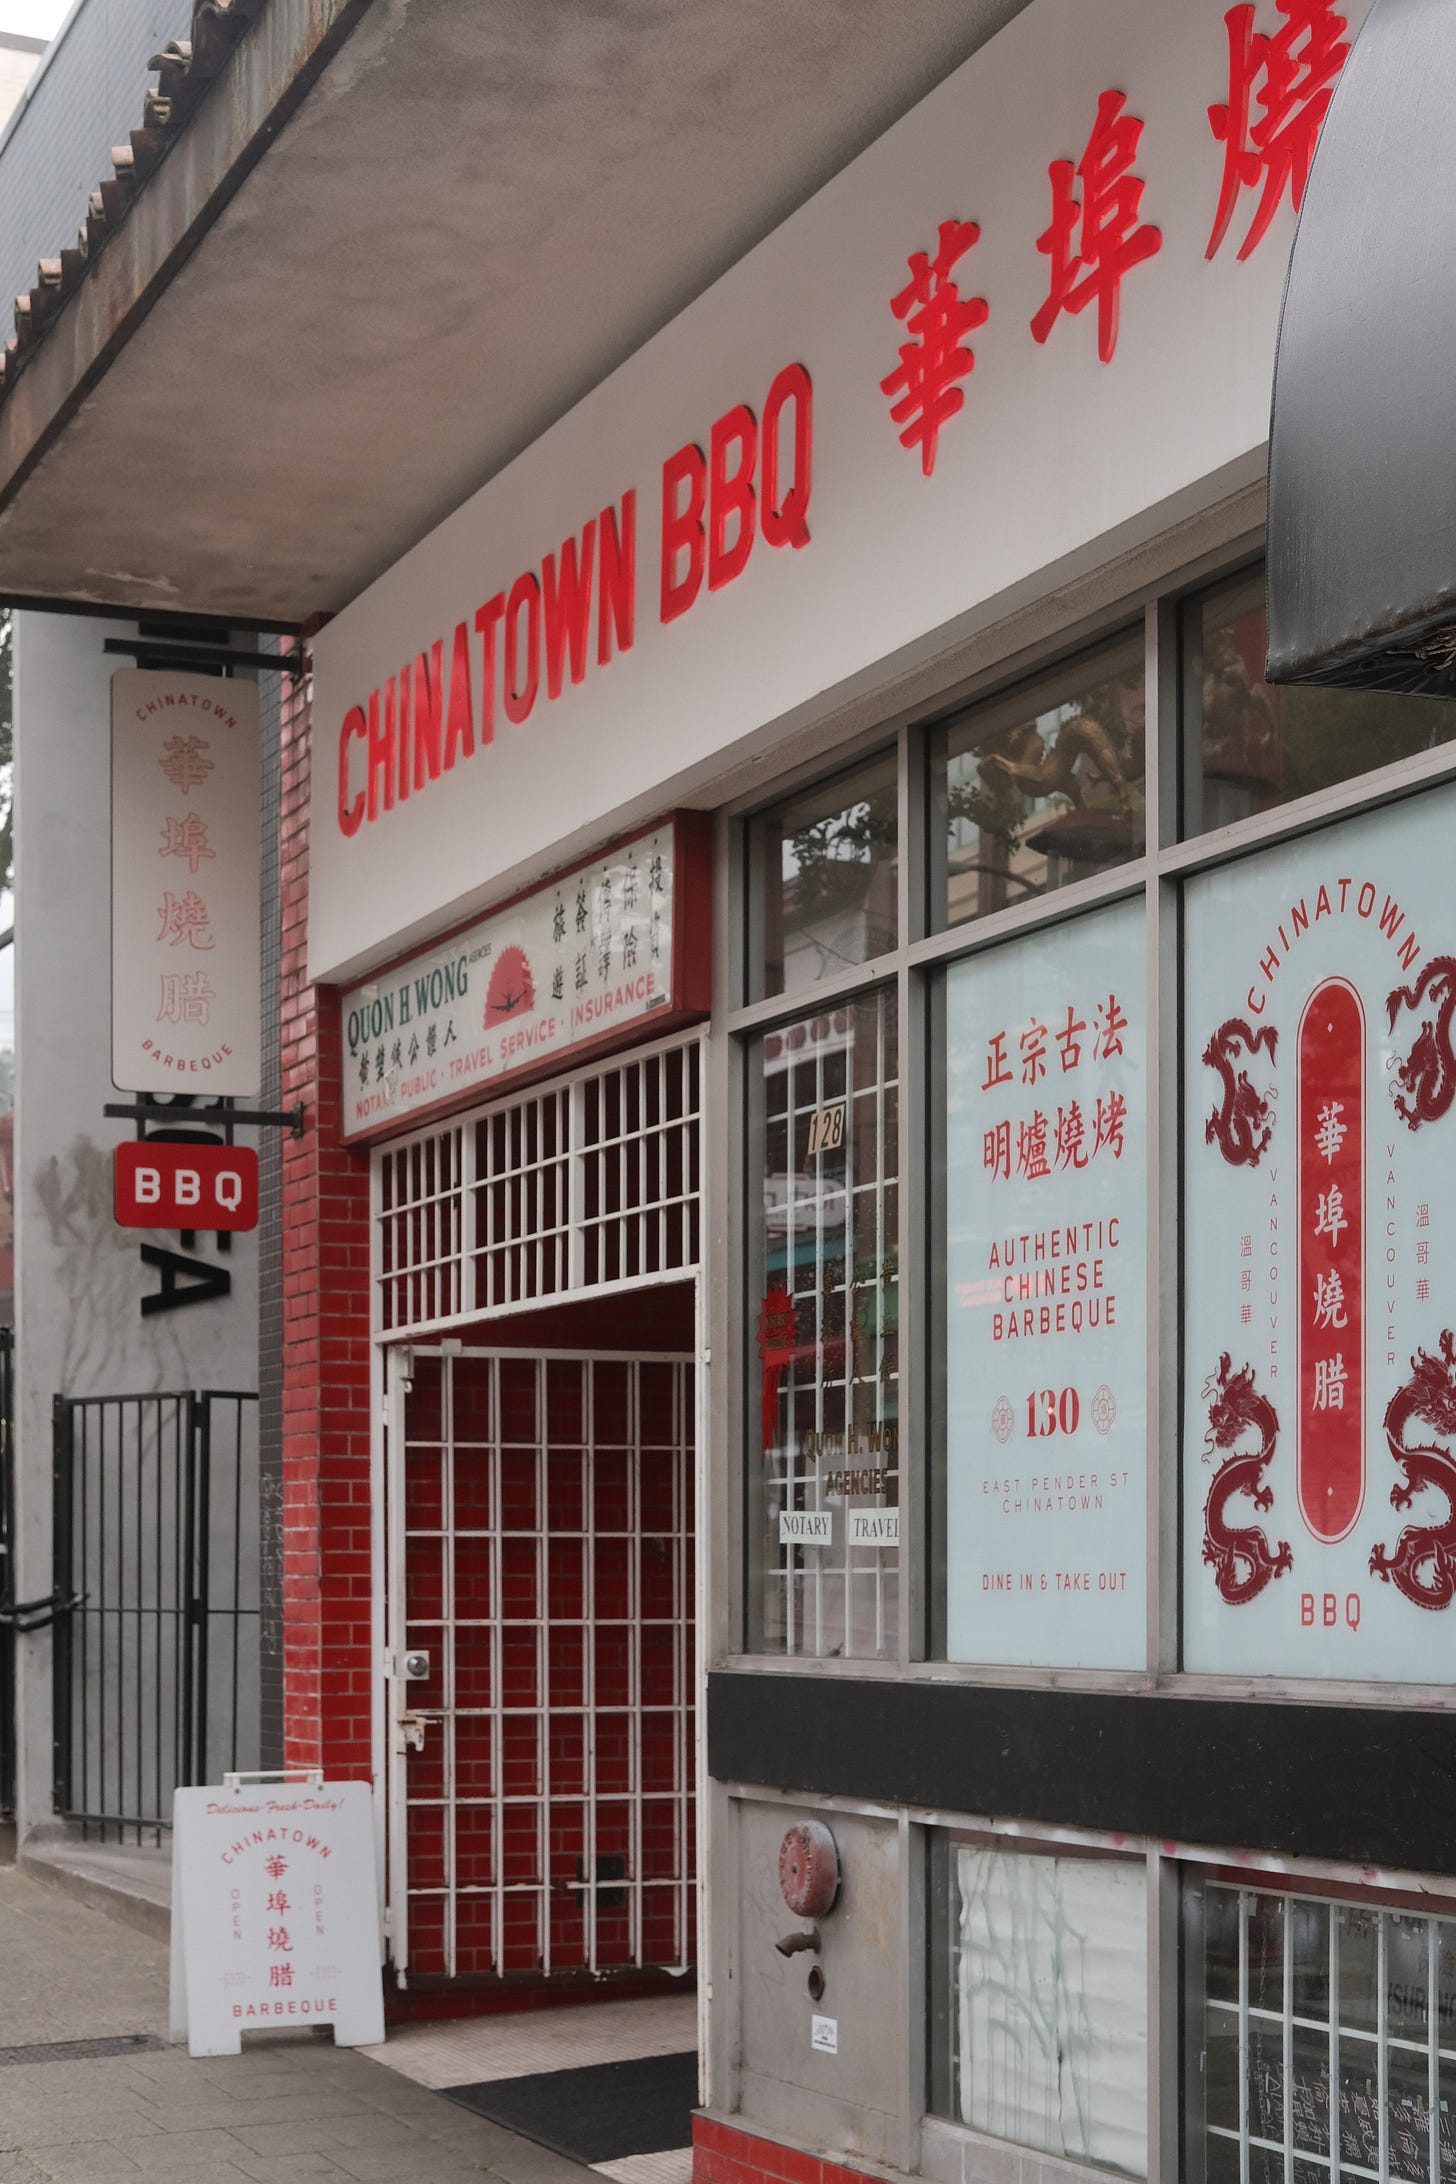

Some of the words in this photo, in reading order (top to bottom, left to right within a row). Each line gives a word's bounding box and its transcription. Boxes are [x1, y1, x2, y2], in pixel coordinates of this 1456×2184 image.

[338, 489, 636, 837] CHINATOWN
[660, 362, 812, 624] BBQ
[135, 693, 238, 730] CHINATOWN
[1248, 878, 1421, 1015] CHINATOWN
[348, 993, 394, 1058] QUON
[414, 957, 468, 1017] WONG
[141, 1038, 233, 1072] BARBEQUE
[400, 1069, 437, 1098] PUBLIC
[449, 1044, 493, 1080] TRAVEL
[500, 1017, 556, 1058] SERVICE
[570, 972, 655, 1027] INSURANCE
[981, 994, 1128, 1091] 正宗古法
[812, 1107, 843, 1152] 128
[983, 1090, 1128, 1183] 明爐燒烤
[135, 1167, 242, 1212] BBQ
[989, 1218, 1119, 1270] AUTHENTIC
[1313, 1101, 1348, 1411] 華埠燒腊
[1387, 1144, 1395, 1366] VANCOUVER
[1004, 1259, 1104, 1303] CHINESE
[1270, 1168, 1278, 1378] VANCOUVER
[993, 1295, 1116, 1341] BARBEQUE
[1026, 1386, 1080, 1437] 130
[825, 1468, 888, 1497] AGENCIES
[983, 1479, 1020, 1494] EAST
[1032, 1474, 1098, 1491] PENDER
[1111, 1472, 1129, 1487] ST
[1002, 1495, 1104, 1513] CHINATOWN
[782, 1516, 830, 1535] NOTARY
[854, 1517, 899, 1538] TRAVEL
[982, 1573, 1012, 1591] DINE
[1020, 1573, 1033, 1591] IN
[1040, 1574, 1048, 1591] &
[1056, 1573, 1090, 1591] TAKE
[1098, 1572, 1127, 1591] OUT
[1301, 1593, 1361, 1631] BBQ
[221, 1827, 333, 1865] CHINATOWN
[231, 1889, 242, 1940] OPEN
[313, 1884, 324, 1935] OPEN
[233, 1998, 337, 2017] BARBEQUE
